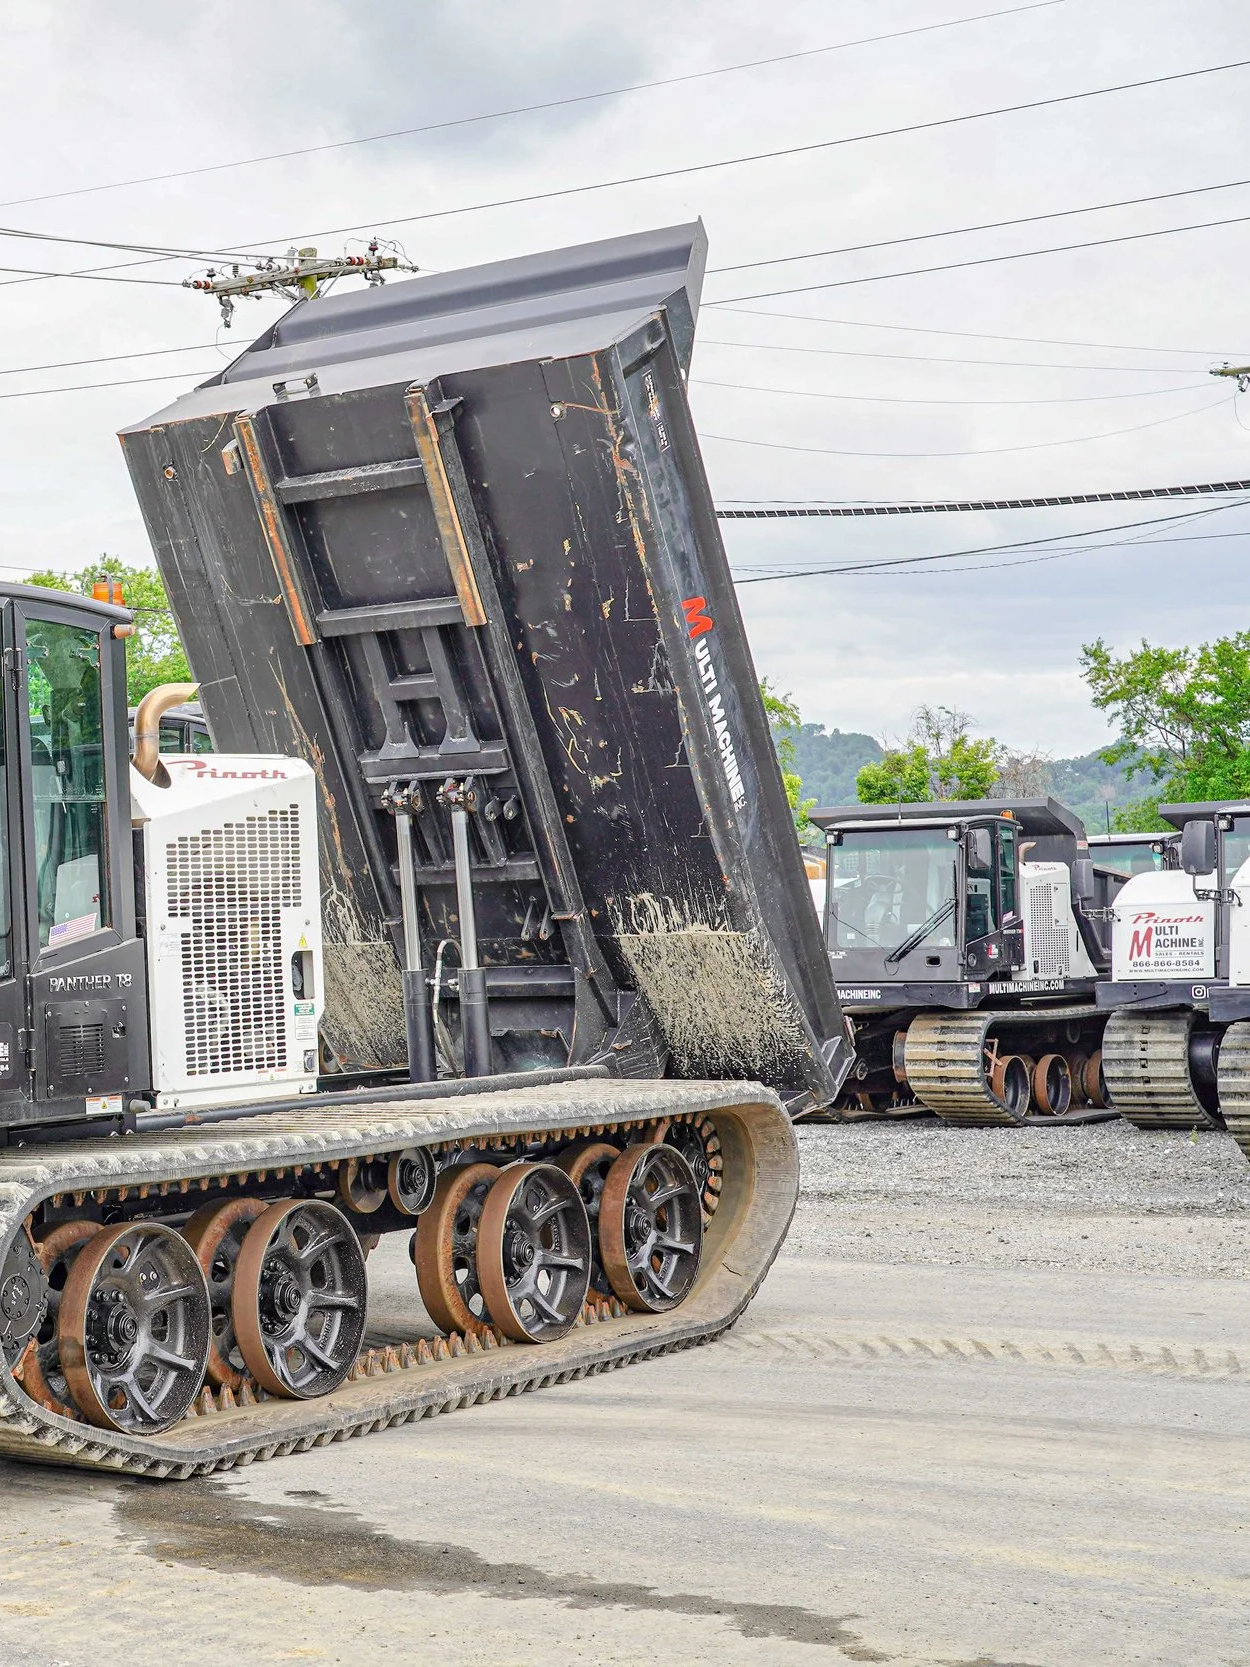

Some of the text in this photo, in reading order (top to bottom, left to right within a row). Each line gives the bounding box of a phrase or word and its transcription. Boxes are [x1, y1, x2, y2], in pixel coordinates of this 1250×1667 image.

[709, 693, 745, 803] MACHINE
[166, 760, 288, 779] Prinoth
[1129, 912, 1205, 924] Prinoth
[1132, 959, 1200, 968] 866-866-8584
[49, 973, 132, 993] PANTHER T8
[989, 979, 1065, 994] MULTIMACHINEINC.COM
